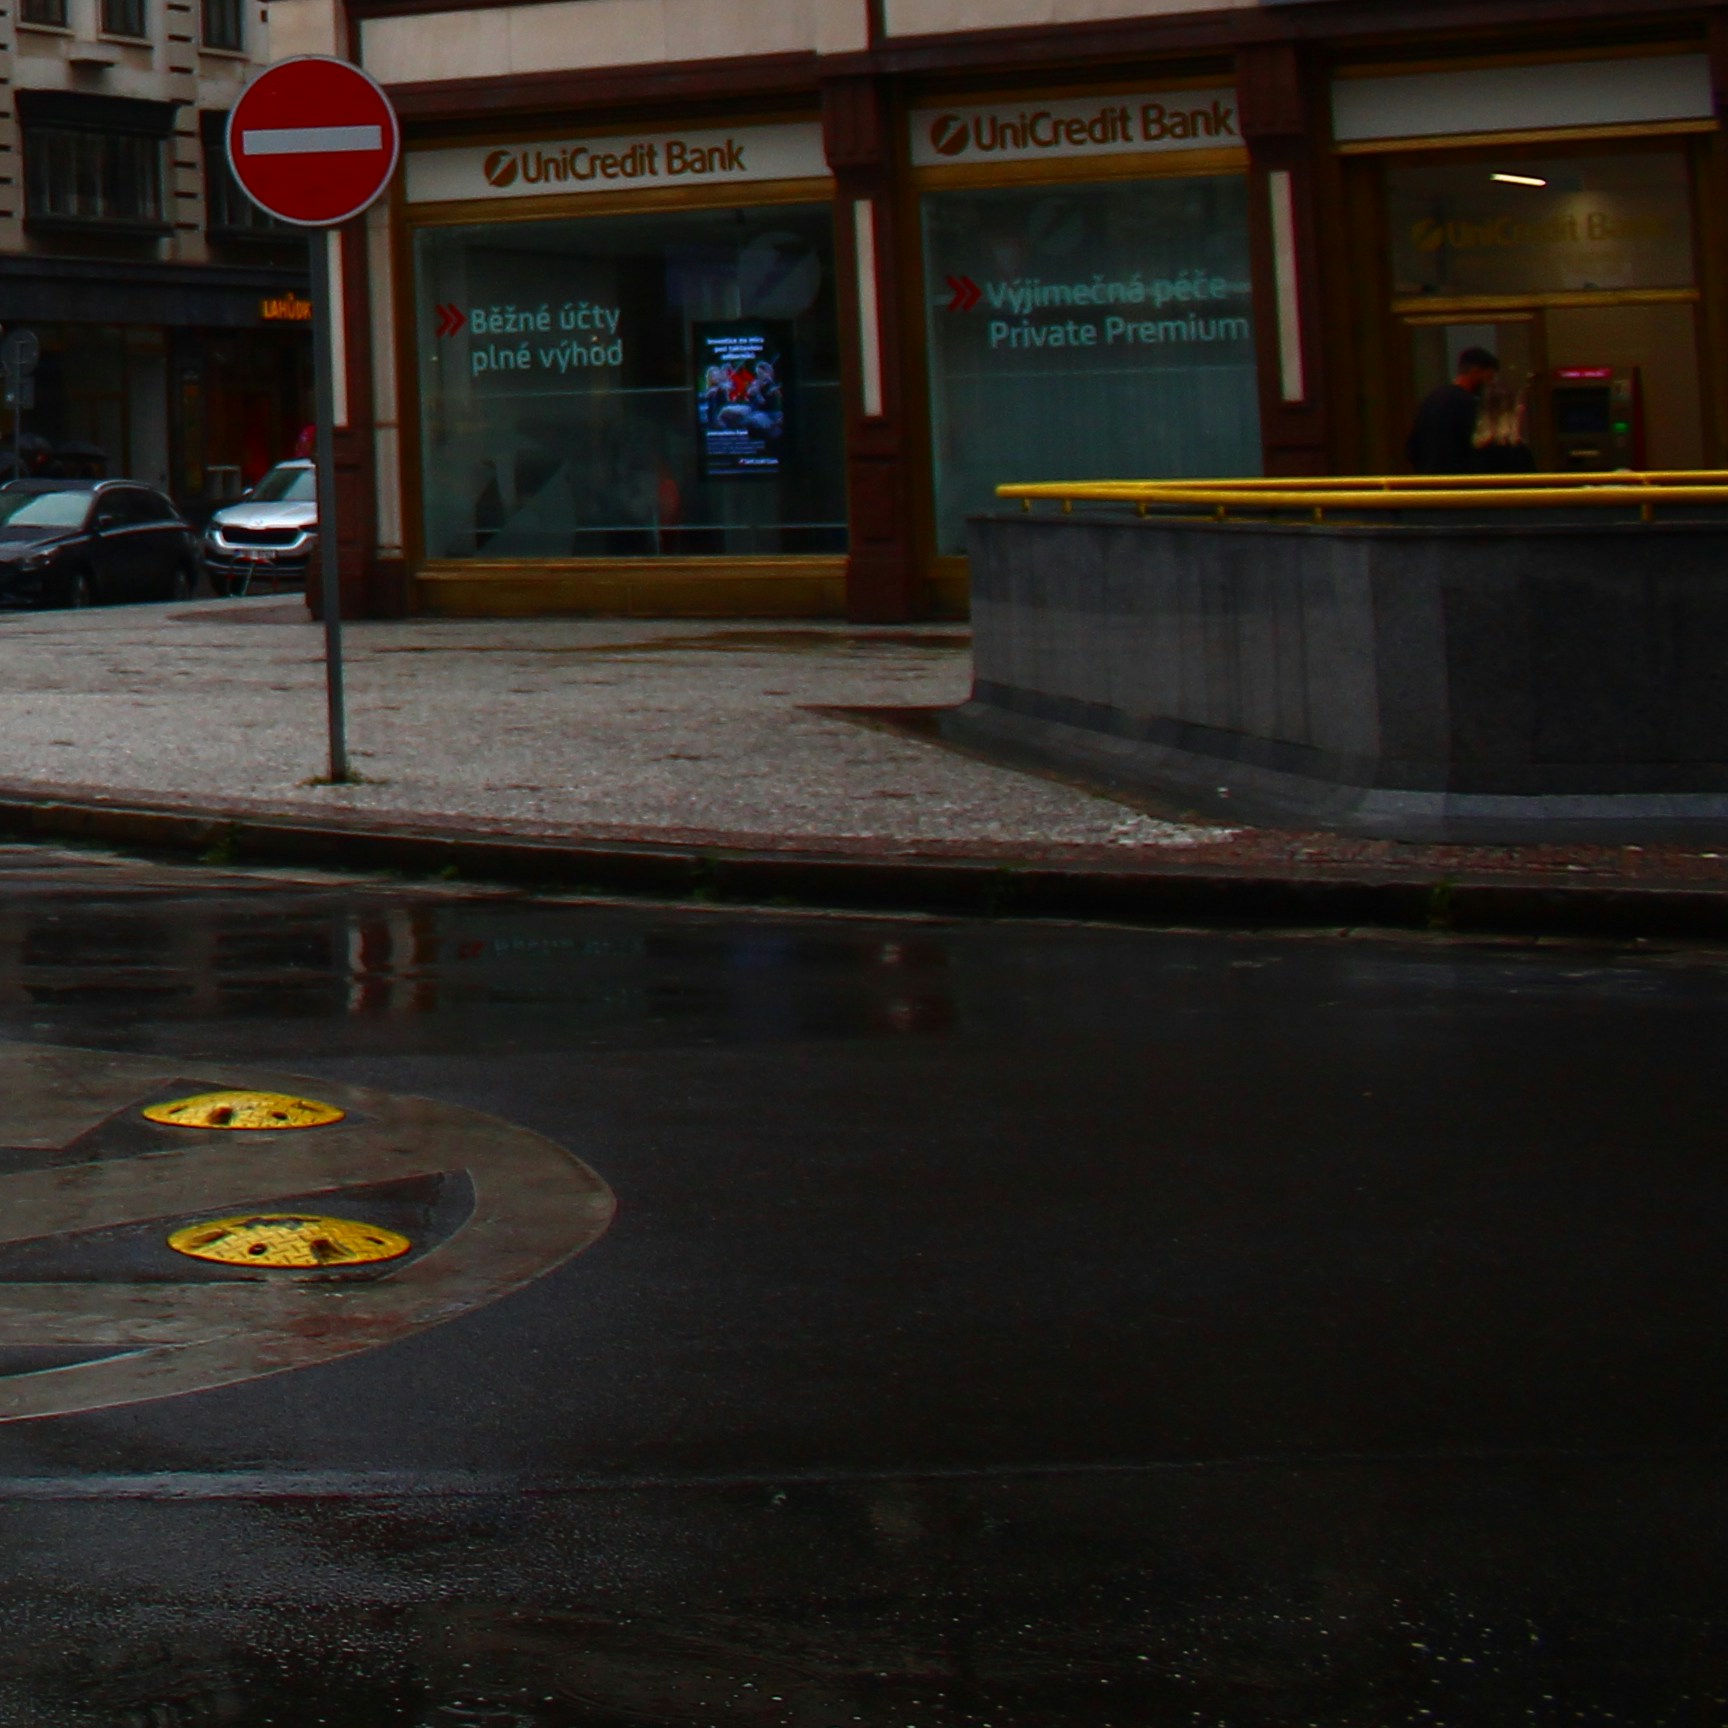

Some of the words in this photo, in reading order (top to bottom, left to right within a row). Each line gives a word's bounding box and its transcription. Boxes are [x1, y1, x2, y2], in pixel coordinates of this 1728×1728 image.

[974, 106, 1134, 152] UniCredit
[1141, 100, 1238, 141] Bank
[521, 143, 658, 184] UniCredit
[666, 138, 747, 176] Bank
[261, 290, 314, 320] LAHŮDK
[985, 272, 1146, 315] Výjimečná
[1152, 269, 1229, 308] péče
[469, 303, 553, 335] Běžné
[559, 300, 622, 335] účty
[988, 318, 1099, 349] Private
[1104, 313, 1250, 344] Premium
[471, 340, 532, 376] plné
[539, 337, 625, 374] výhod
